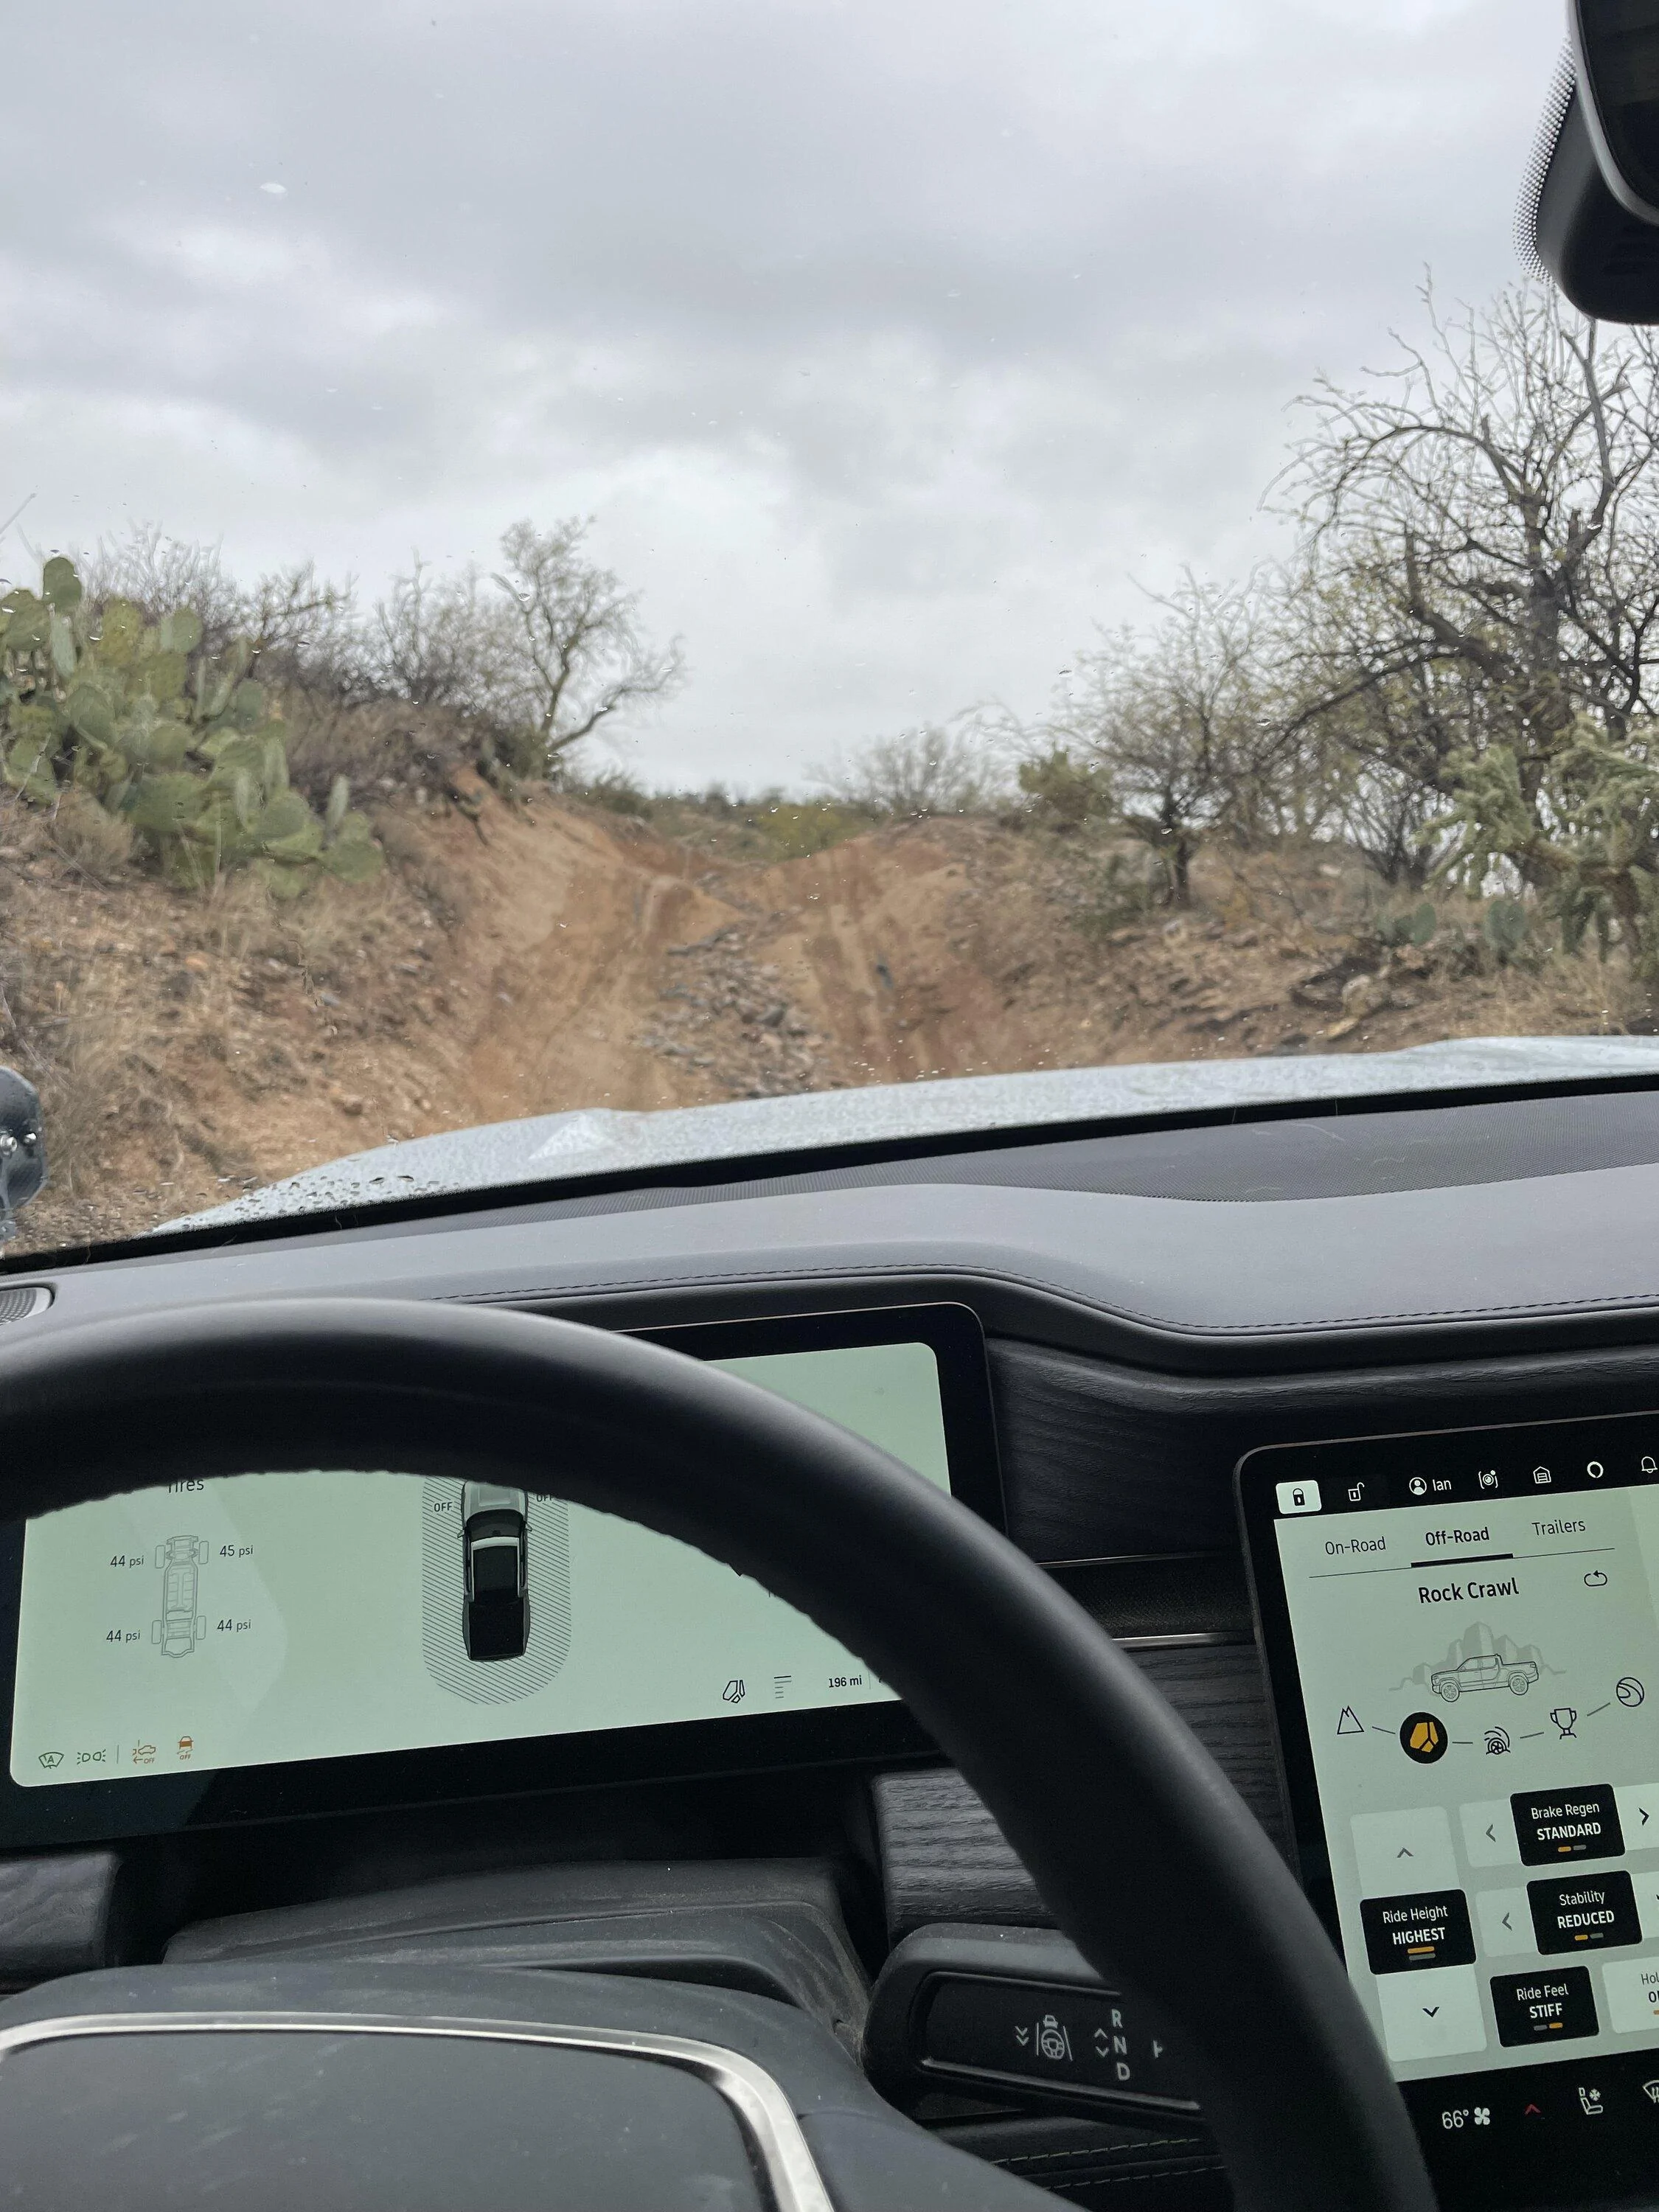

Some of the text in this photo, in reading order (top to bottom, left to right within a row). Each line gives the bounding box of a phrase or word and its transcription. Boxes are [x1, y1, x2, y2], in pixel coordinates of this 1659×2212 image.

[1432, 1478, 1452, 1492] Ian
[434, 1502, 453, 1512] OFF
[1531, 1519, 1586, 1536] Trailers
[1425, 1527, 1490, 1546] Off-Road
[220, 1545, 254, 1557] 45 psi
[1325, 1536, 1386, 1555] On-Road
[110, 1555, 144, 1569] 44 psi
[1418, 1577, 1520, 1604] Rock Crawl
[217, 1619, 251, 1632] 44 psi
[106, 1630, 140, 1643] 44 psi
[828, 1674, 862, 1688] 196 mi
[1531, 1803, 1600, 1820] Brake Regen
[1537, 1822, 1601, 1841] STANDARD
[1559, 1890, 1606, 1907] Stability
[1382, 1905, 1449, 1924] Ride Height
[1557, 1910, 1615, 1930] REDUCED
[1392, 1927, 1446, 1945] HIGHEST
[1516, 1983, 1570, 2001] Ride Feel
[1111, 2008, 1124, 2028] R
[1529, 2003, 1563, 2019] STIFF
[1113, 2035, 1127, 2055] N
[1116, 2062, 1130, 2081] D
